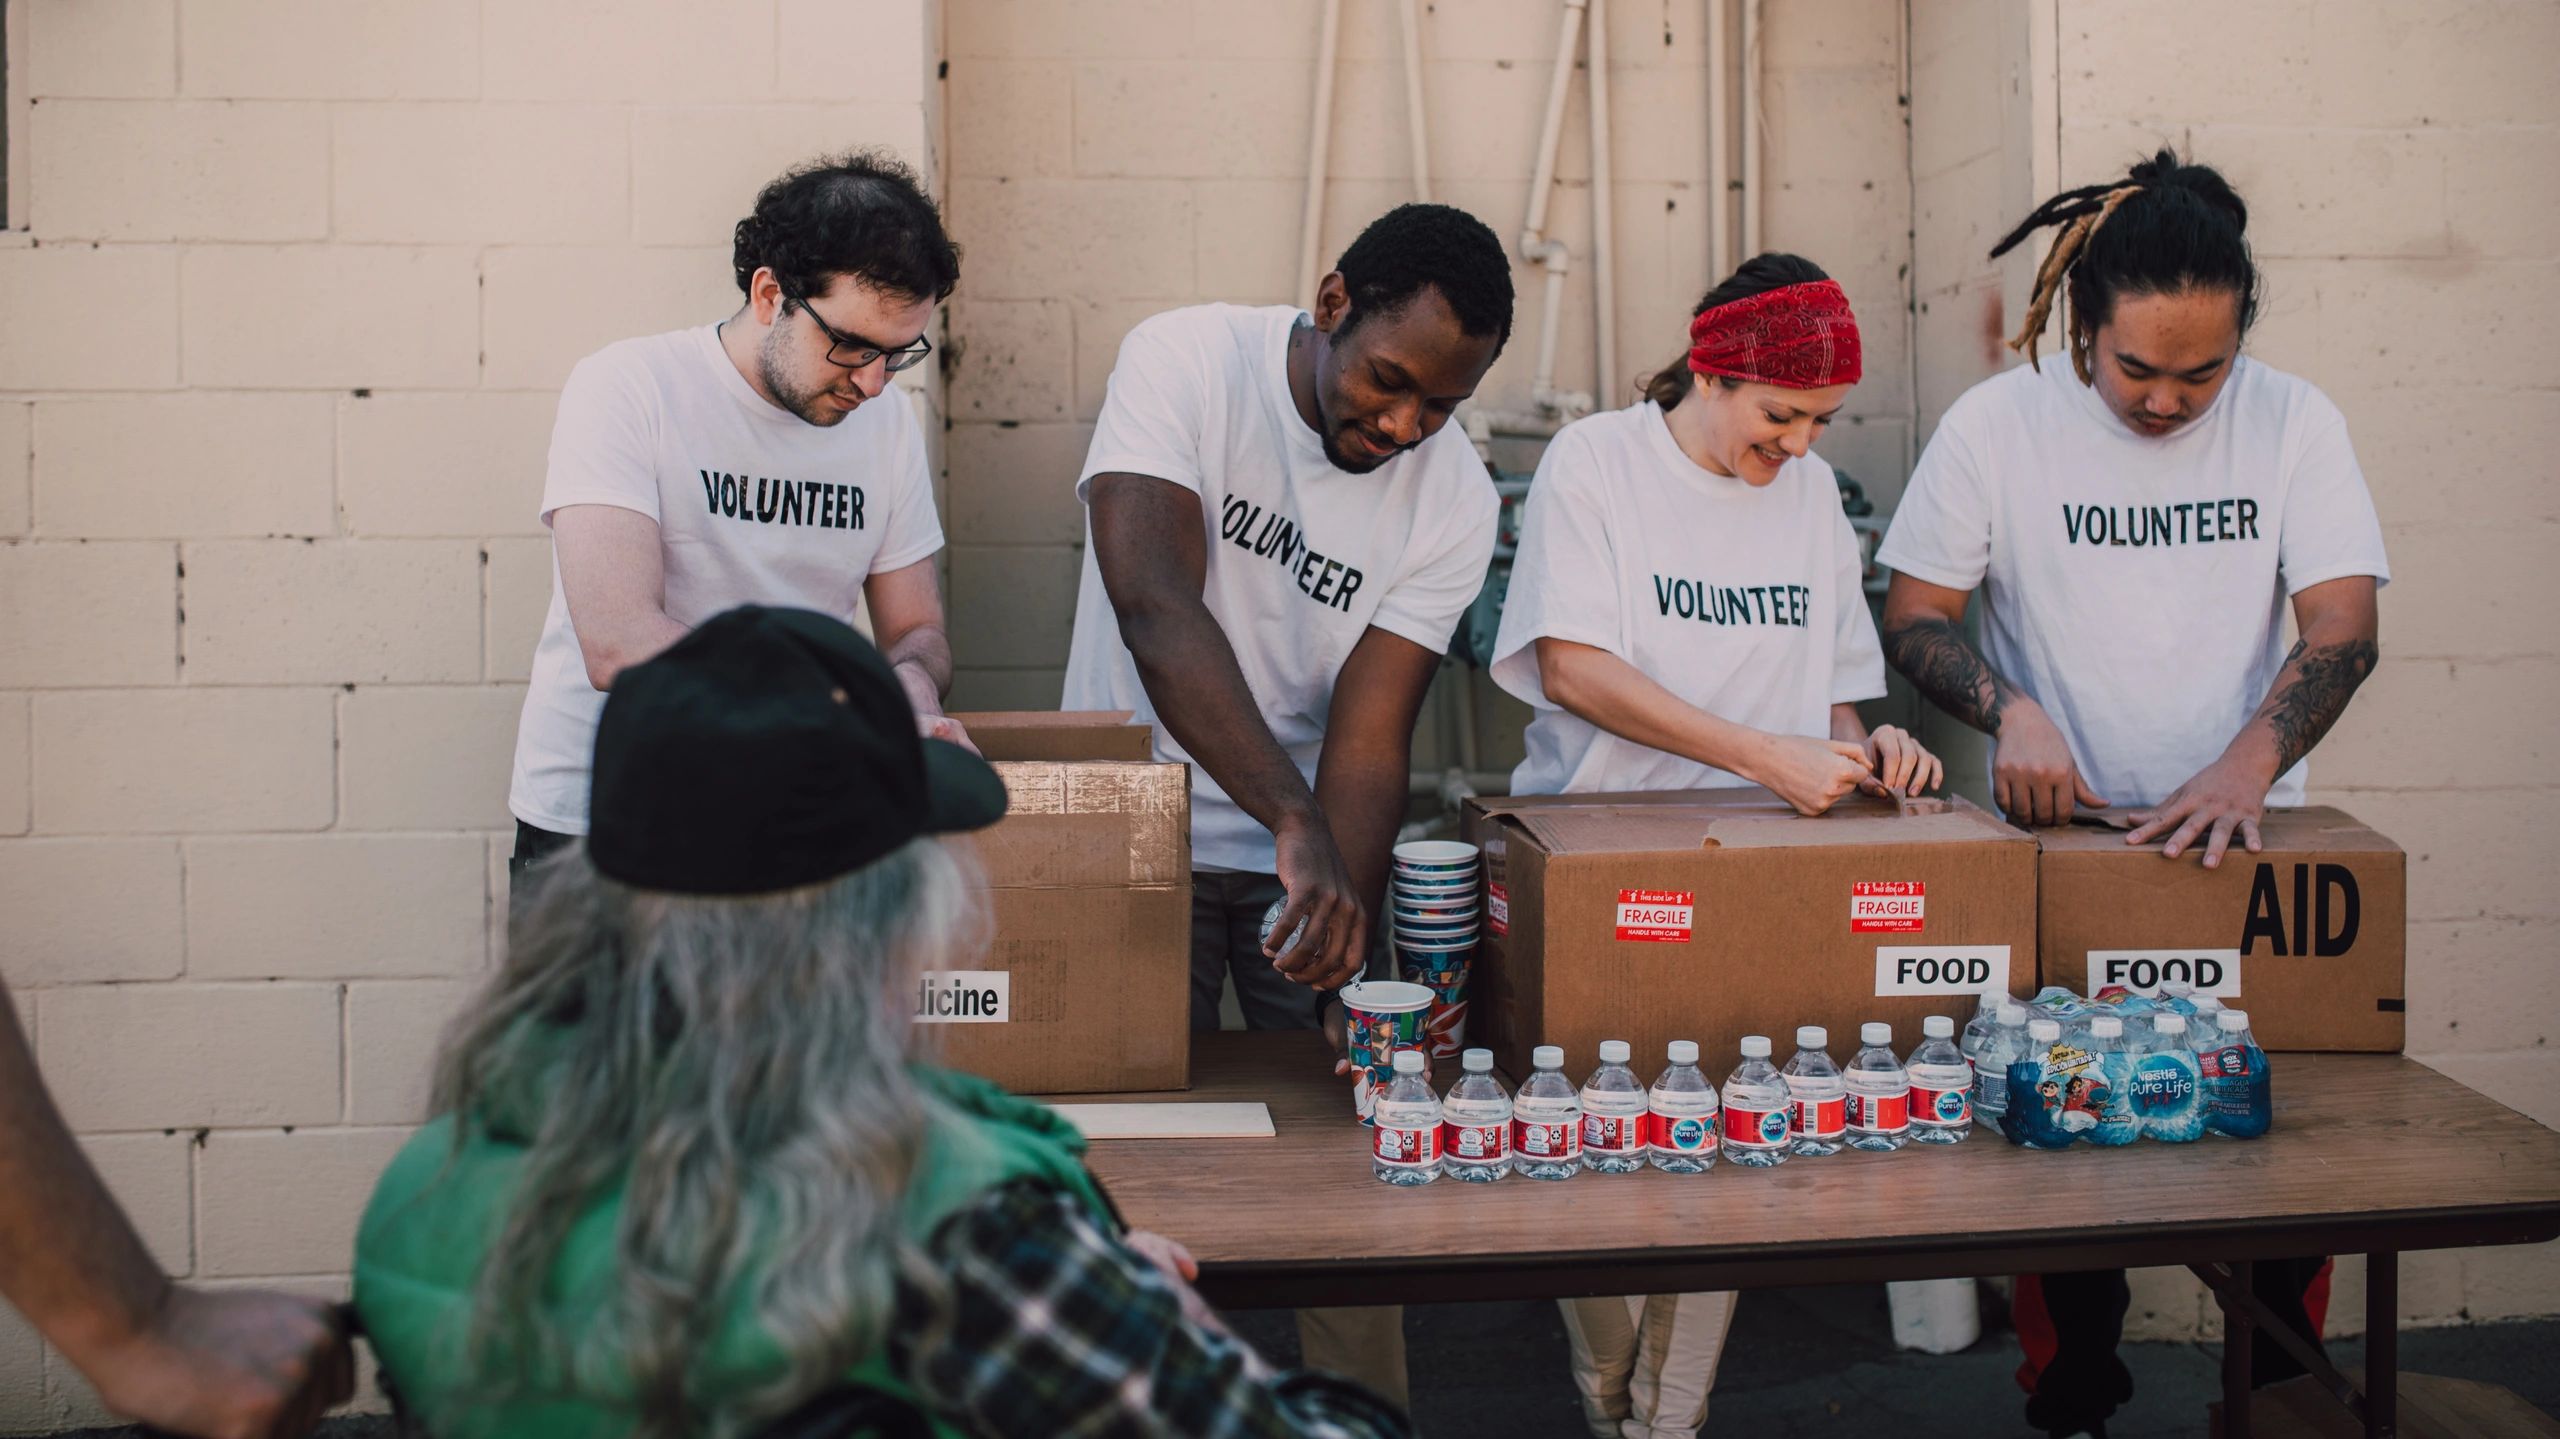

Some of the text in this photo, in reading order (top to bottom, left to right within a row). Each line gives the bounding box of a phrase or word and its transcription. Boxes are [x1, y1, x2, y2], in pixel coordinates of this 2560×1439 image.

[700, 469, 865, 530] VOLUNTEER
[2062, 498, 2259, 547] VOLUNTEER
[1223, 493, 1363, 613] OLUNTEER
[1653, 574, 1810, 629] VOLUNTEER
[1624, 909, 1687, 925] FRAGILE
[1858, 901, 1919, 915] FRAGILE
[2240, 863, 2360, 957] AID
[1862, 920, 1913, 928] HANDLE WITH CARE
[1897, 958, 1990, 985] FOOD
[2106, 958, 2223, 989] FOOD
[2130, 1080, 2192, 1099] Pure Life
[1691, 1130, 1702, 1139] Life
[1763, 1123, 1776, 1131] Pure
